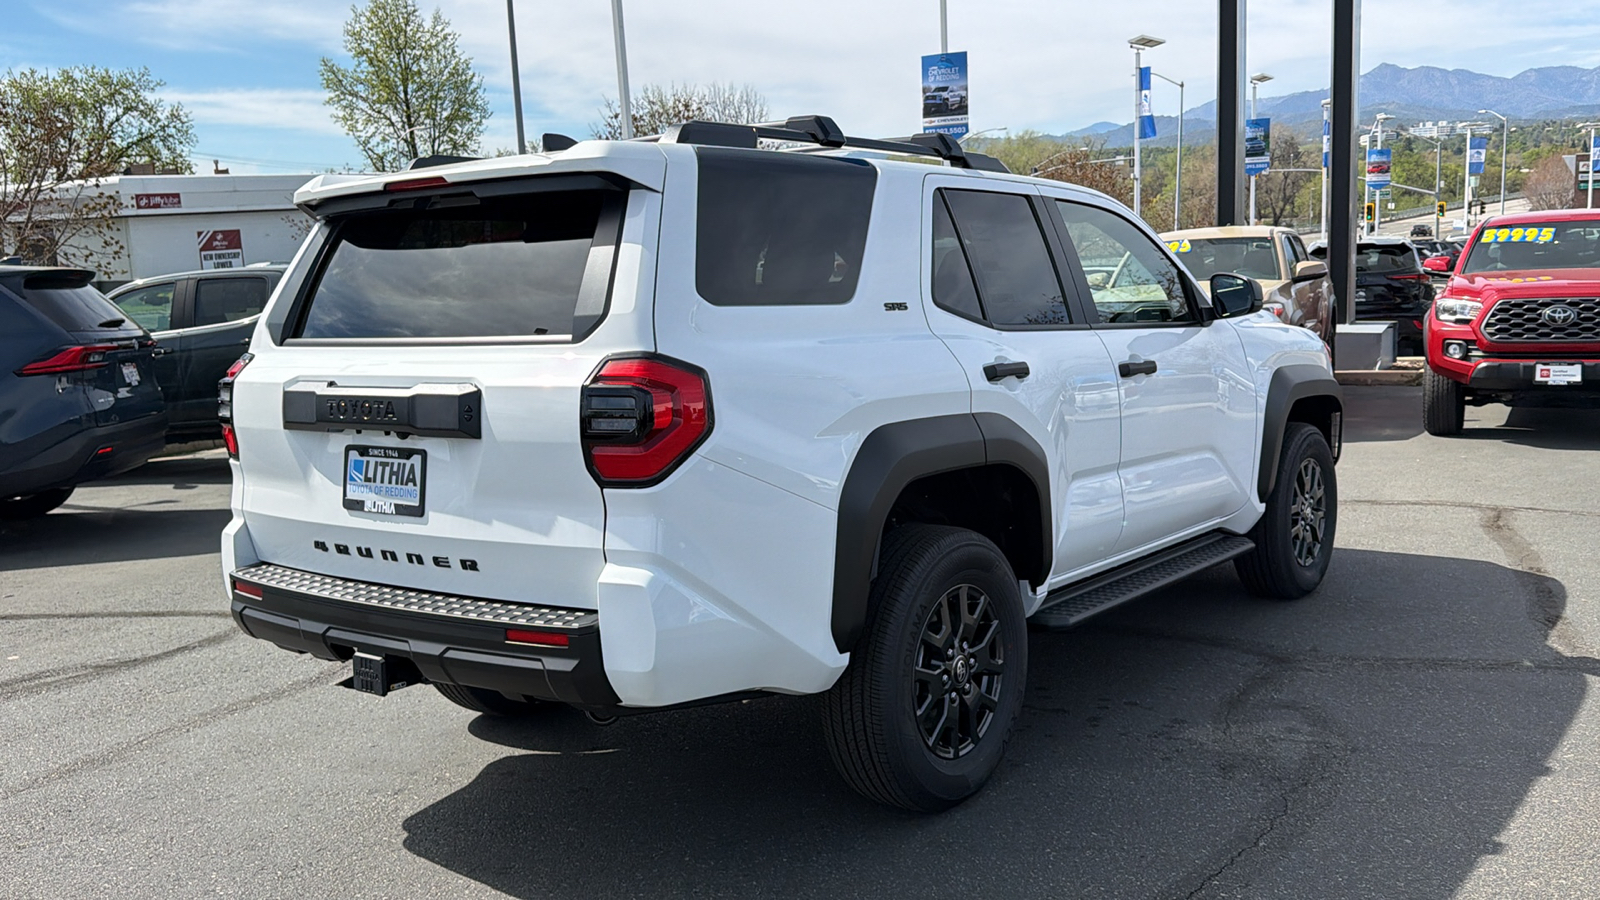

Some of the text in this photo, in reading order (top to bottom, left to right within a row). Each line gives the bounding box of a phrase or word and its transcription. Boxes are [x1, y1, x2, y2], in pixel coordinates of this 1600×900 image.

[928, 67, 959, 76] CHEVROLET
[1480, 228, 1555, 243] 39995
[203, 251, 241, 261] NEW OWNERSHIP
[213, 260, 233, 269] LOWER
[883, 302, 909, 311] SR5
[327, 399, 397, 420] TOYOTA
[368, 448, 399, 458] SINCE 1946
[364, 460, 418, 487] LITHIA
[349, 483, 418, 499] TOYOTA OF REDDING
[314, 540, 480, 572] 4RUNNER
